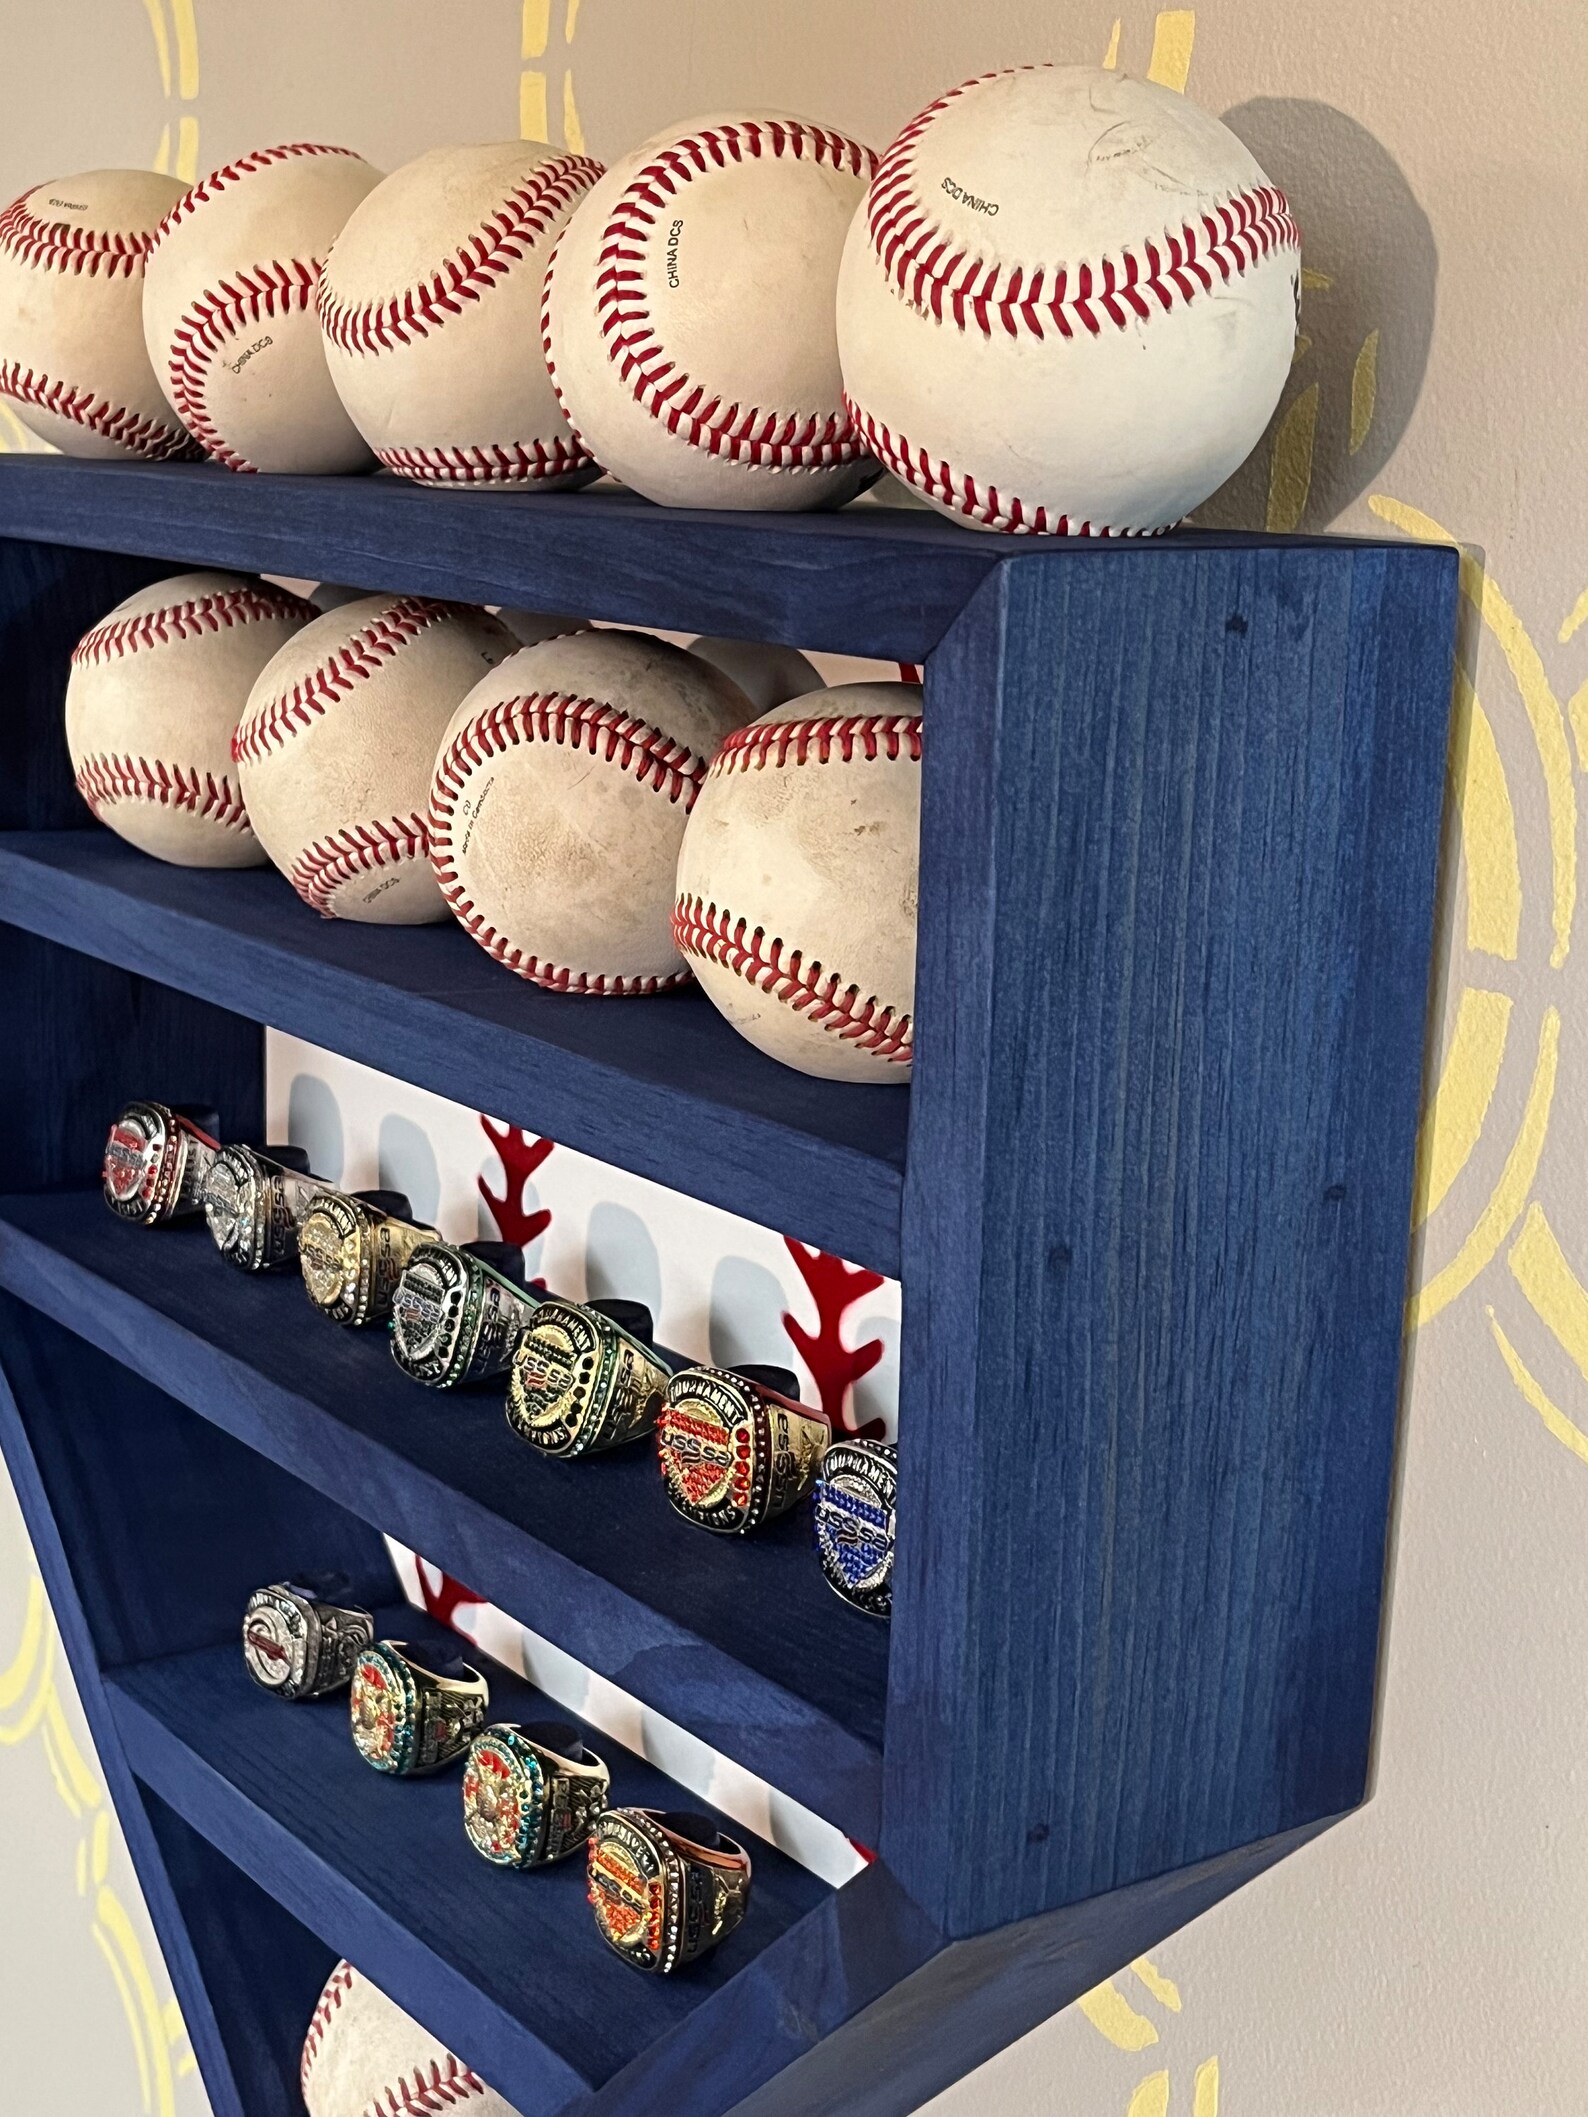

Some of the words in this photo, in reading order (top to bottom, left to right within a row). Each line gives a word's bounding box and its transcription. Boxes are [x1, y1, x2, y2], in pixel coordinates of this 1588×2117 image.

[941, 177, 963, 200] DCS
[962, 192, 999, 216] CHINA
[667, 219, 684, 247] DCS
[666, 248, 680, 288] CHINA
